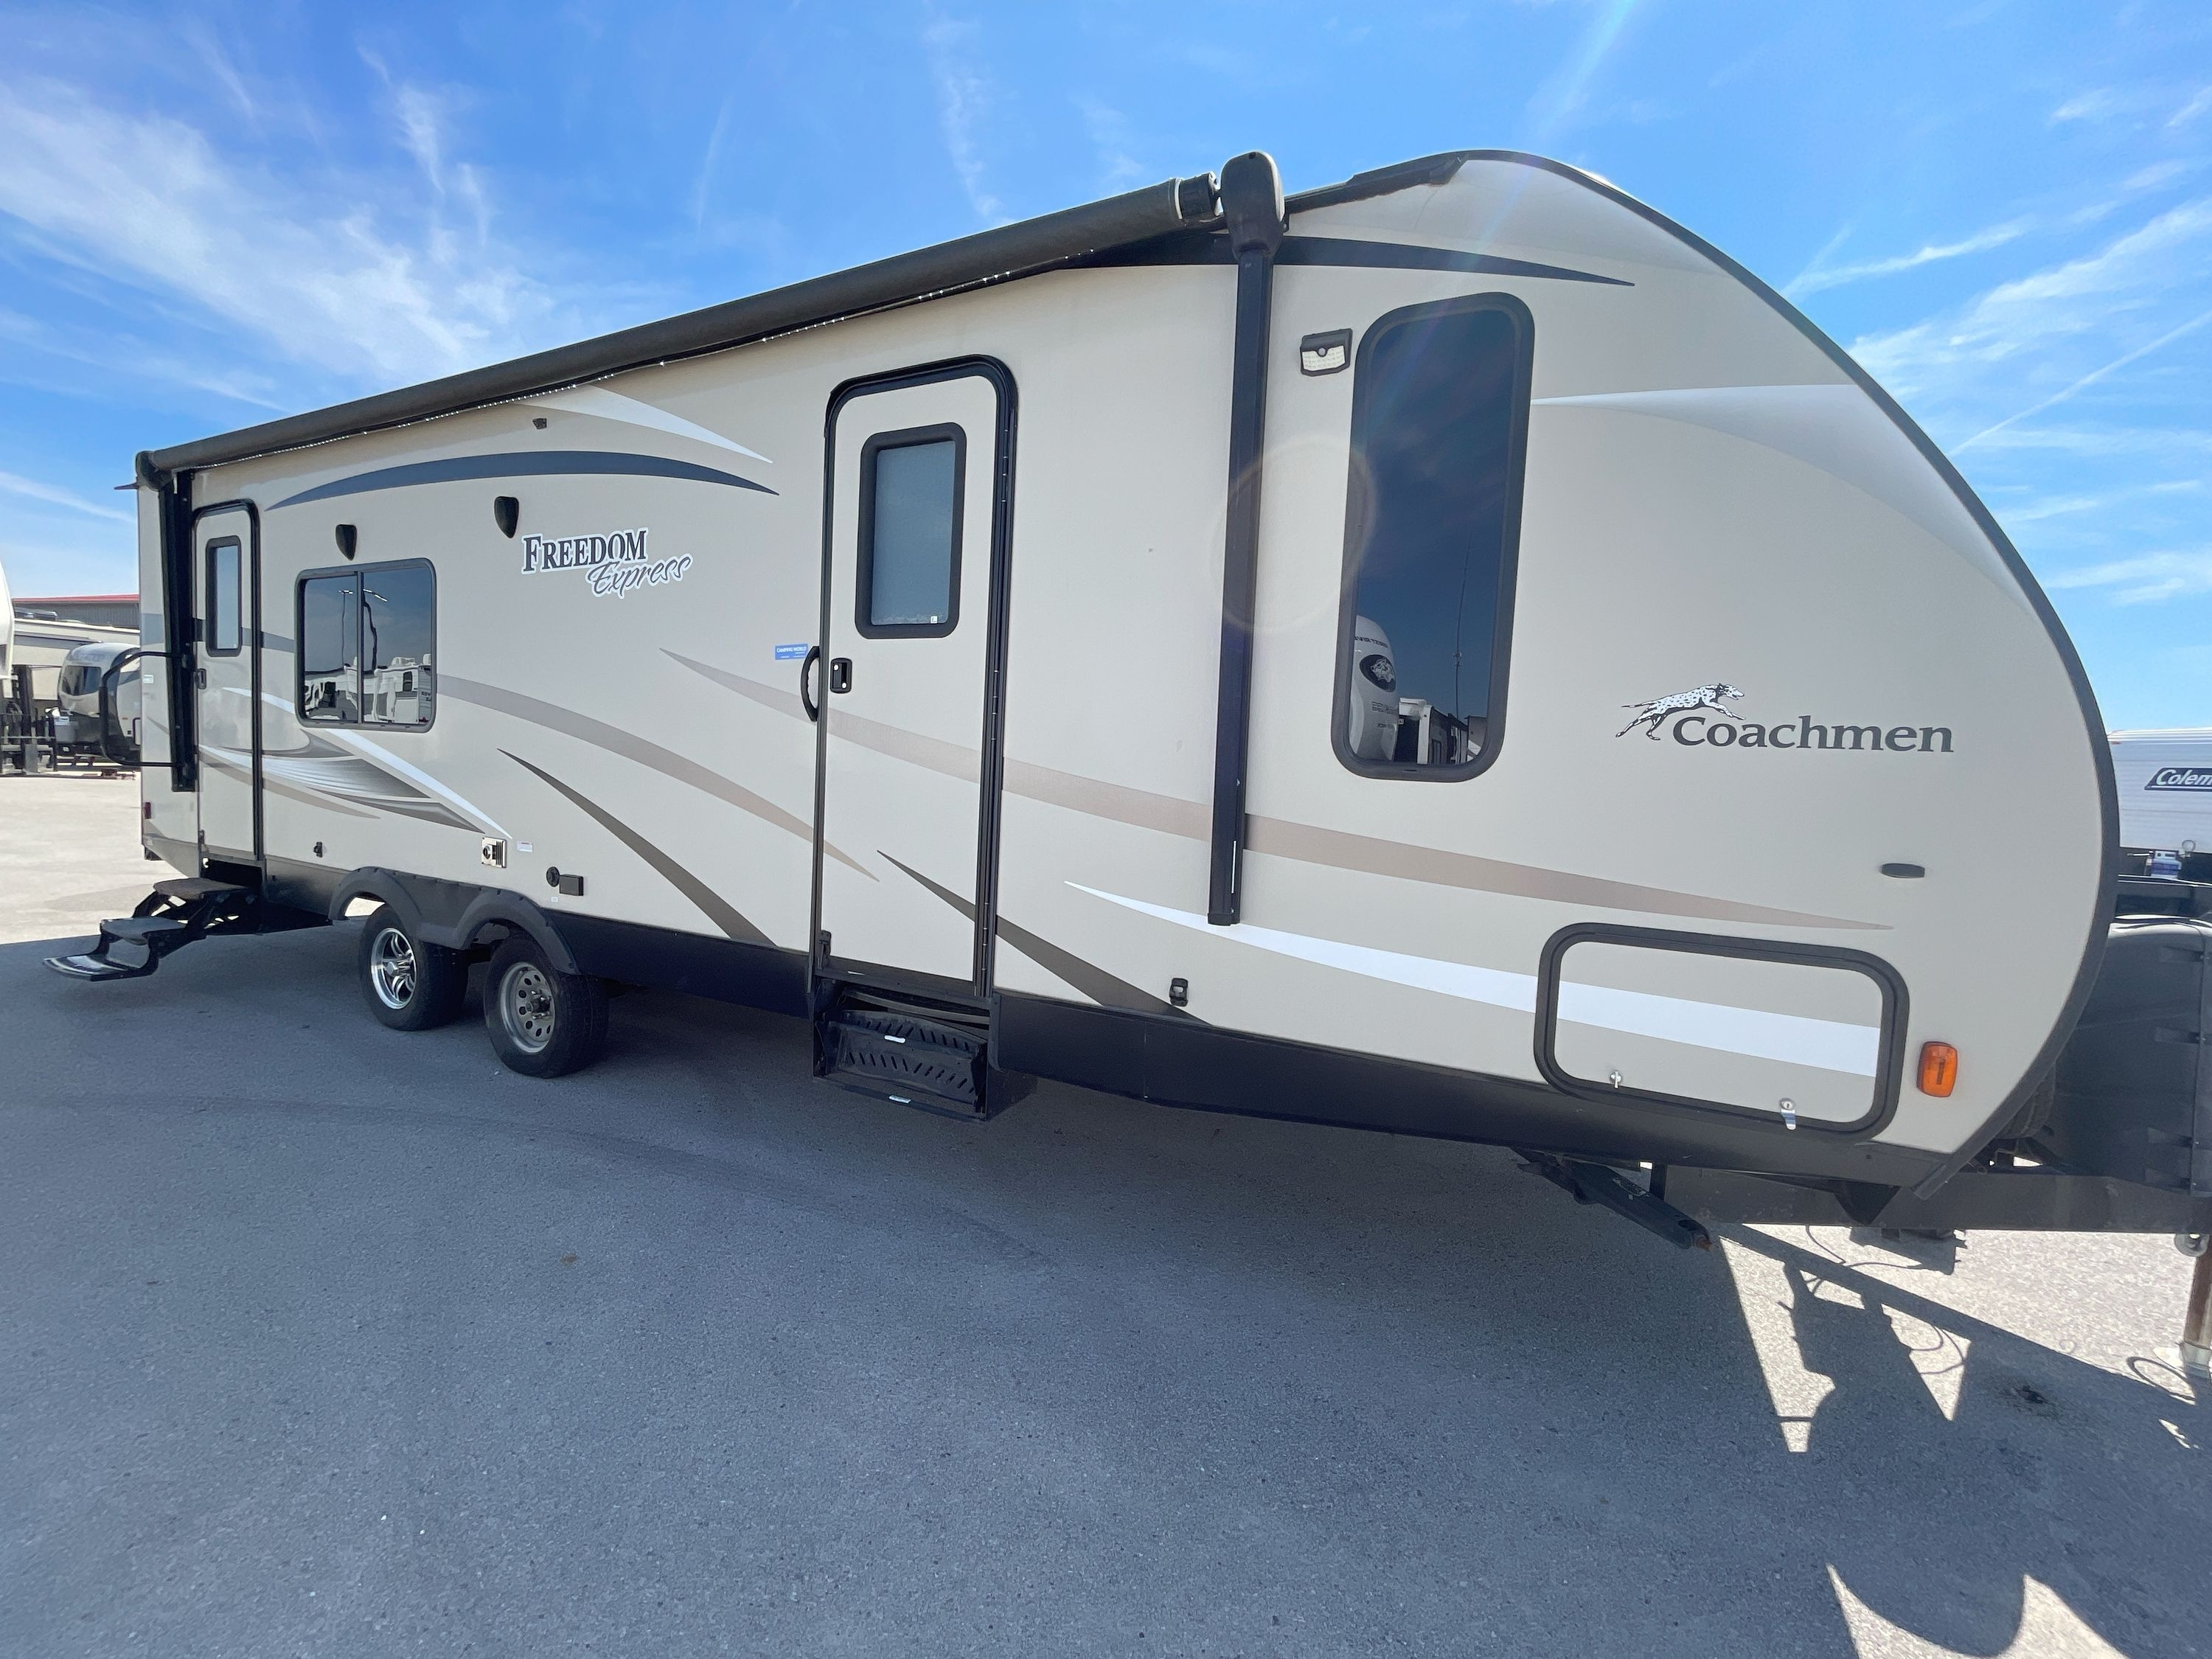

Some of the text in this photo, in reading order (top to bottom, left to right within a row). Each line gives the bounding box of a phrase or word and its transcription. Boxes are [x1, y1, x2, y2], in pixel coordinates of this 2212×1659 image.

[523, 529, 647, 572] FREEDOM
[587, 555, 692, 597] Express
[1672, 714, 1955, 753] Coachmen
